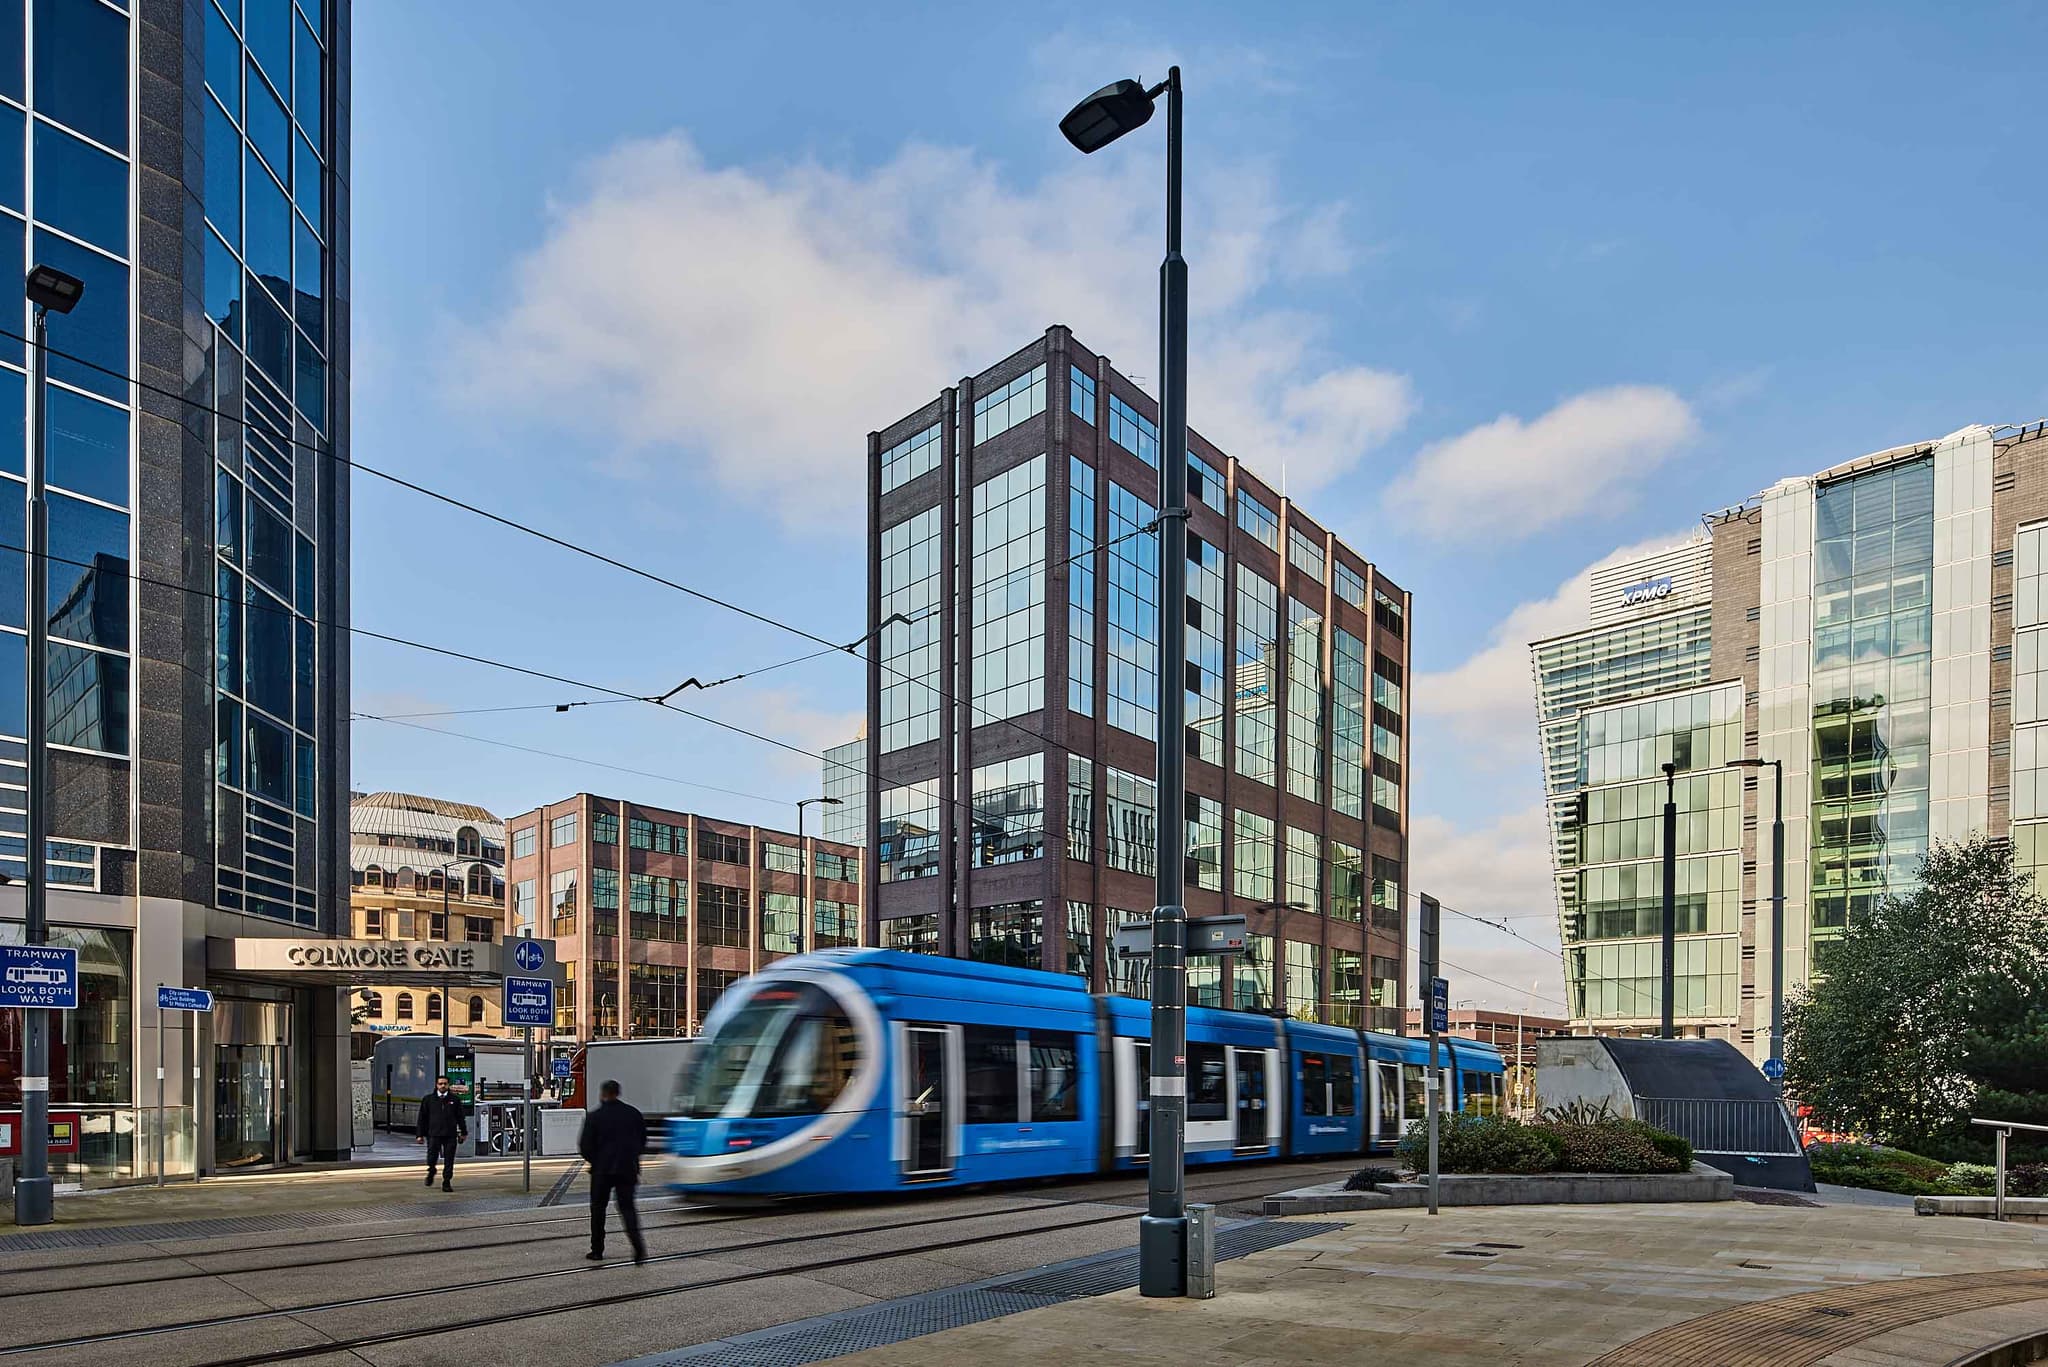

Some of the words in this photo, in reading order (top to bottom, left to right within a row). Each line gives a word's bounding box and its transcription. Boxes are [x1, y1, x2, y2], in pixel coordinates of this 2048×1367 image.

[1621, 583, 1668, 605] KPMG
[6, 949, 67, 960] TRAMWAY
[287, 945, 406, 968] COLMORE
[414, 946, 473, 968] GATE
[512, 980, 547, 989] TRAMWAY
[1, 985, 35, 994] LOOK
[39, 986, 72, 996] BOTH
[19, 995, 54, 1004] WAYS
[378, 1024, 412, 1032] BARCLAYS
